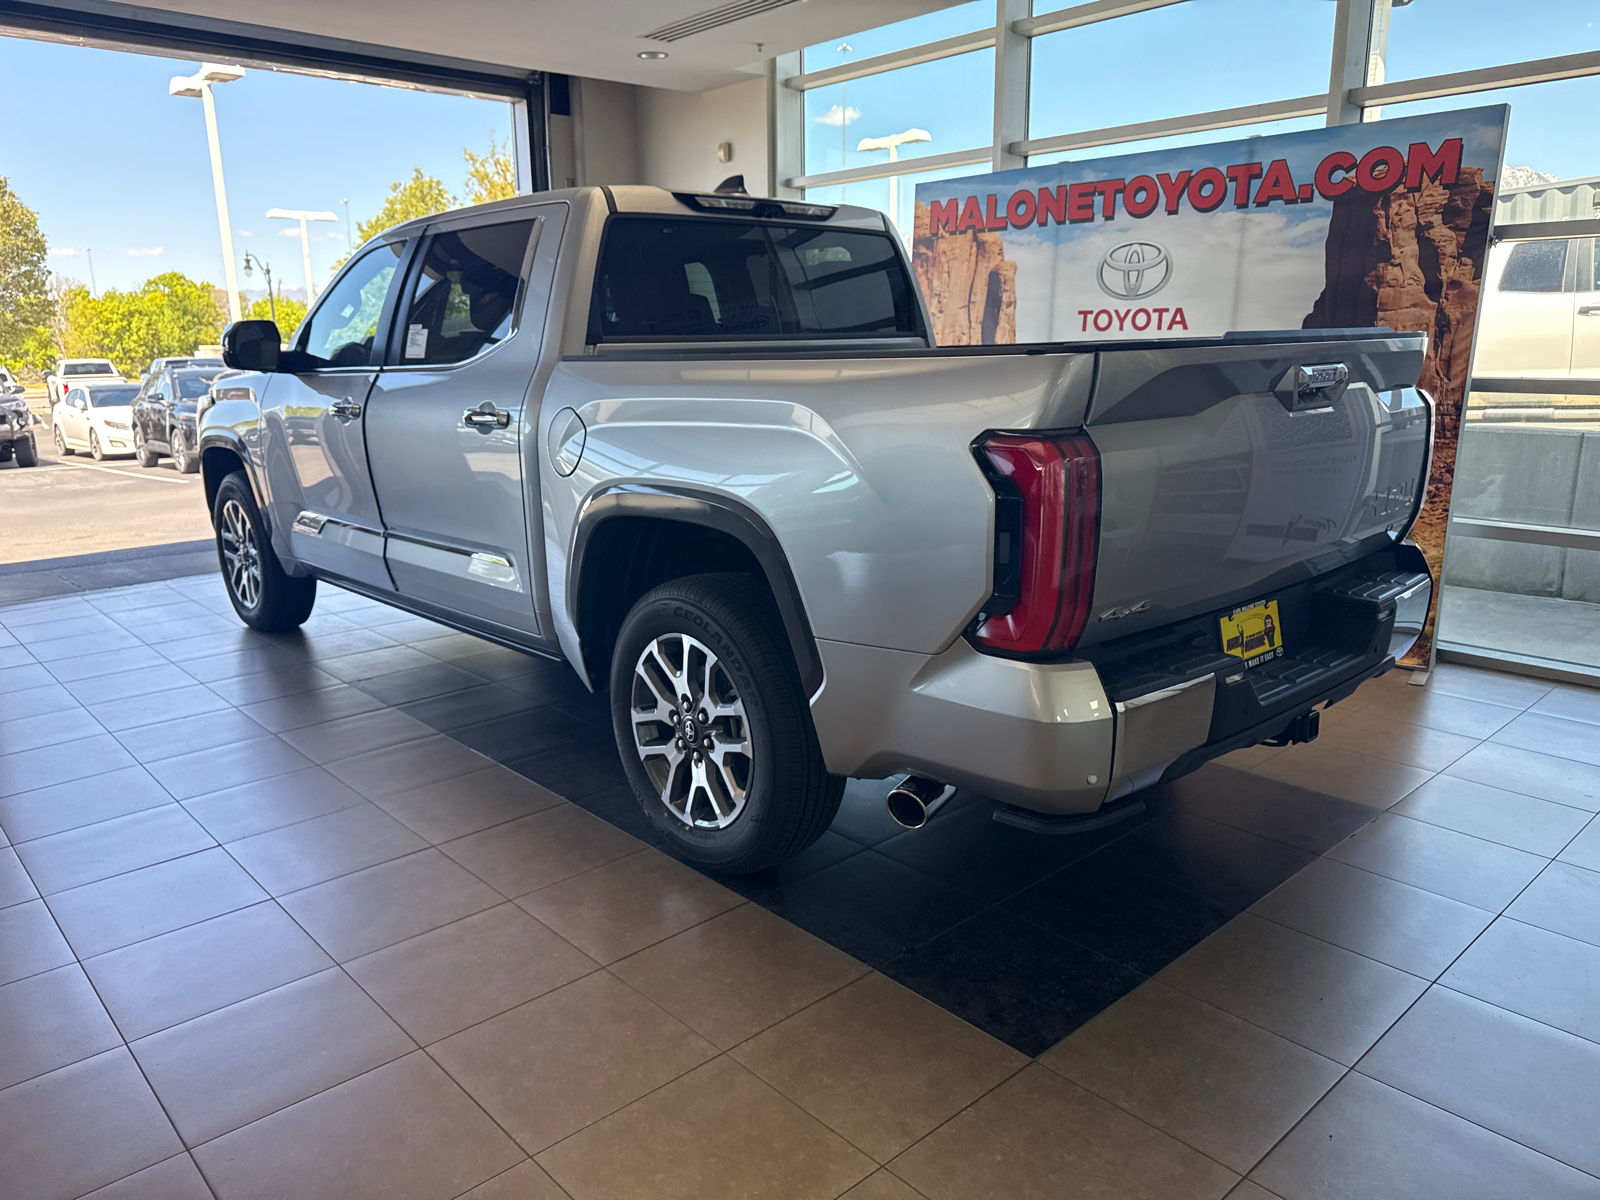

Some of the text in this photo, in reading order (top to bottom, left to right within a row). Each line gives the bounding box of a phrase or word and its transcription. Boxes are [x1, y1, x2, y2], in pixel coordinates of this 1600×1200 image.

[928, 137, 1465, 237] MALONETOYOTA.COM
[1077, 307, 1189, 332] TOYOTA
[1265, 618, 1272, 628] 32
[673, 606, 759, 708] GEOLANDAR
[1248, 656, 1260, 668] MAKE
[1260, 654, 1265, 664] IT
[1264, 651, 1274, 662] EASY
